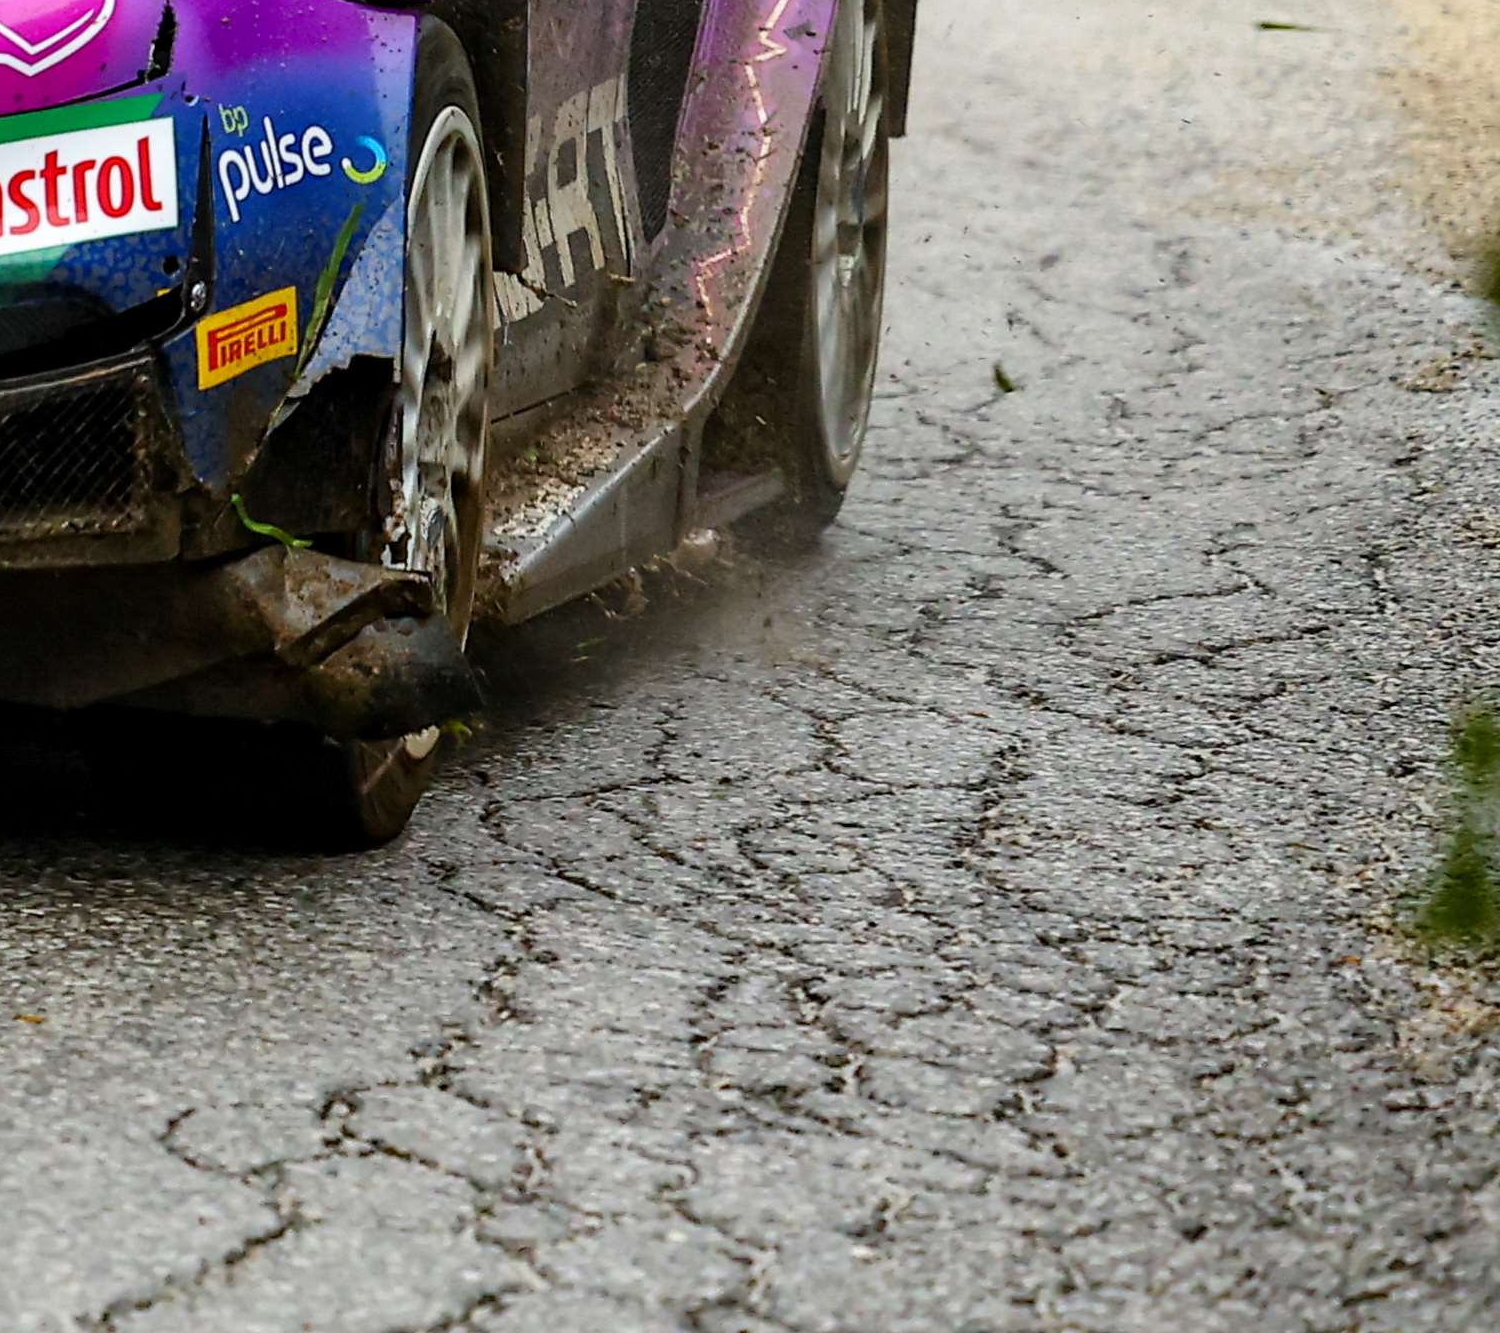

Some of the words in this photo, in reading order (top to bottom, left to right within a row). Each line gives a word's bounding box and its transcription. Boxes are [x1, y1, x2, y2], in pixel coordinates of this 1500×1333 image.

[220, 104, 249, 135] bp
[219, 117, 334, 222] pulse
[207, 301, 288, 372] PIRELLI
